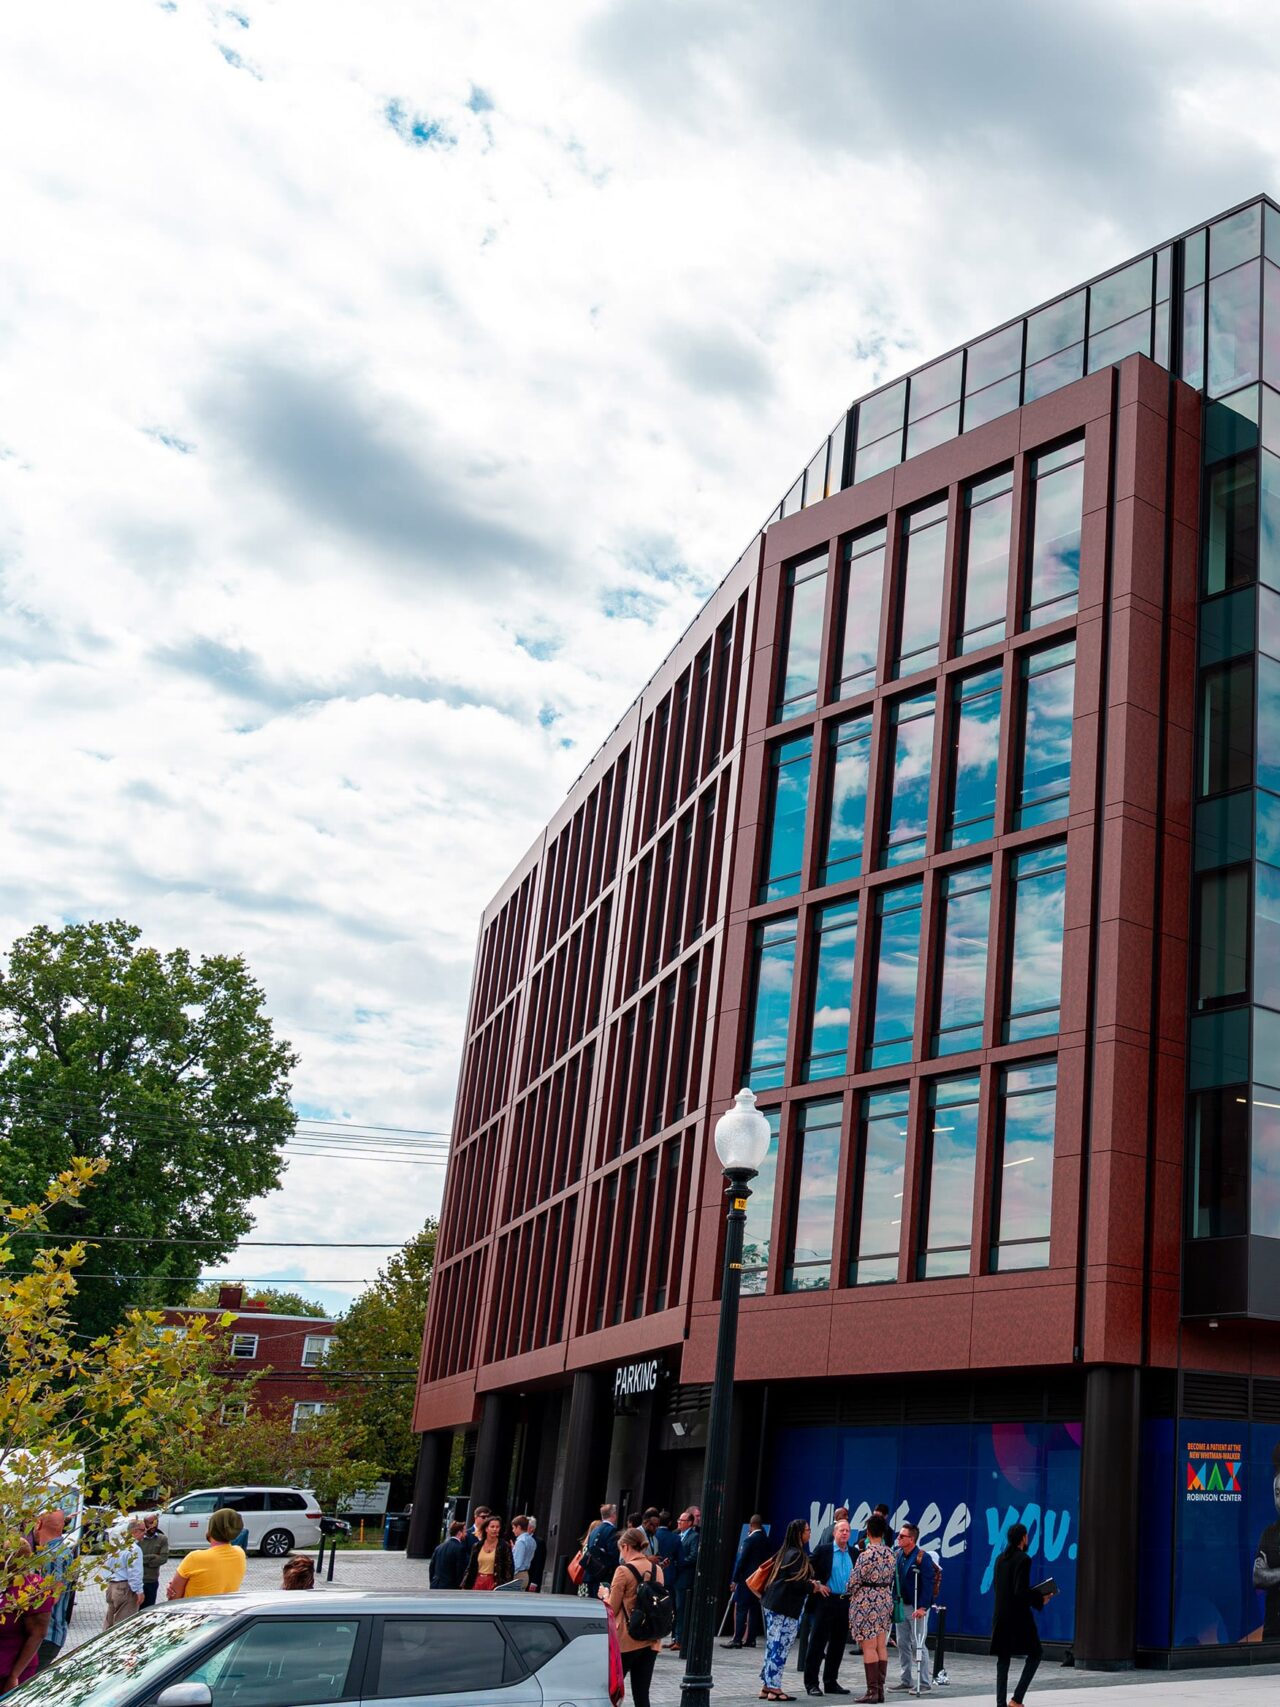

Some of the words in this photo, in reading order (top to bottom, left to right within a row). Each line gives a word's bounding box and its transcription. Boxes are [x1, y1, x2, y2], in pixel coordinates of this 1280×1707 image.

[614, 1359, 658, 1396] PARKING
[1189, 1451, 1200, 1459] NEW
[1200, 1452, 1241, 1460] WHITMAN-WALKER
[1233, 1444, 1242, 1452] THE
[1187, 1461, 1242, 1491] MAX
[1186, 1493, 1219, 1502] ROBINSON
[1219, 1494, 1242, 1502] CENTER
[980, 1503, 1078, 1595] you.
